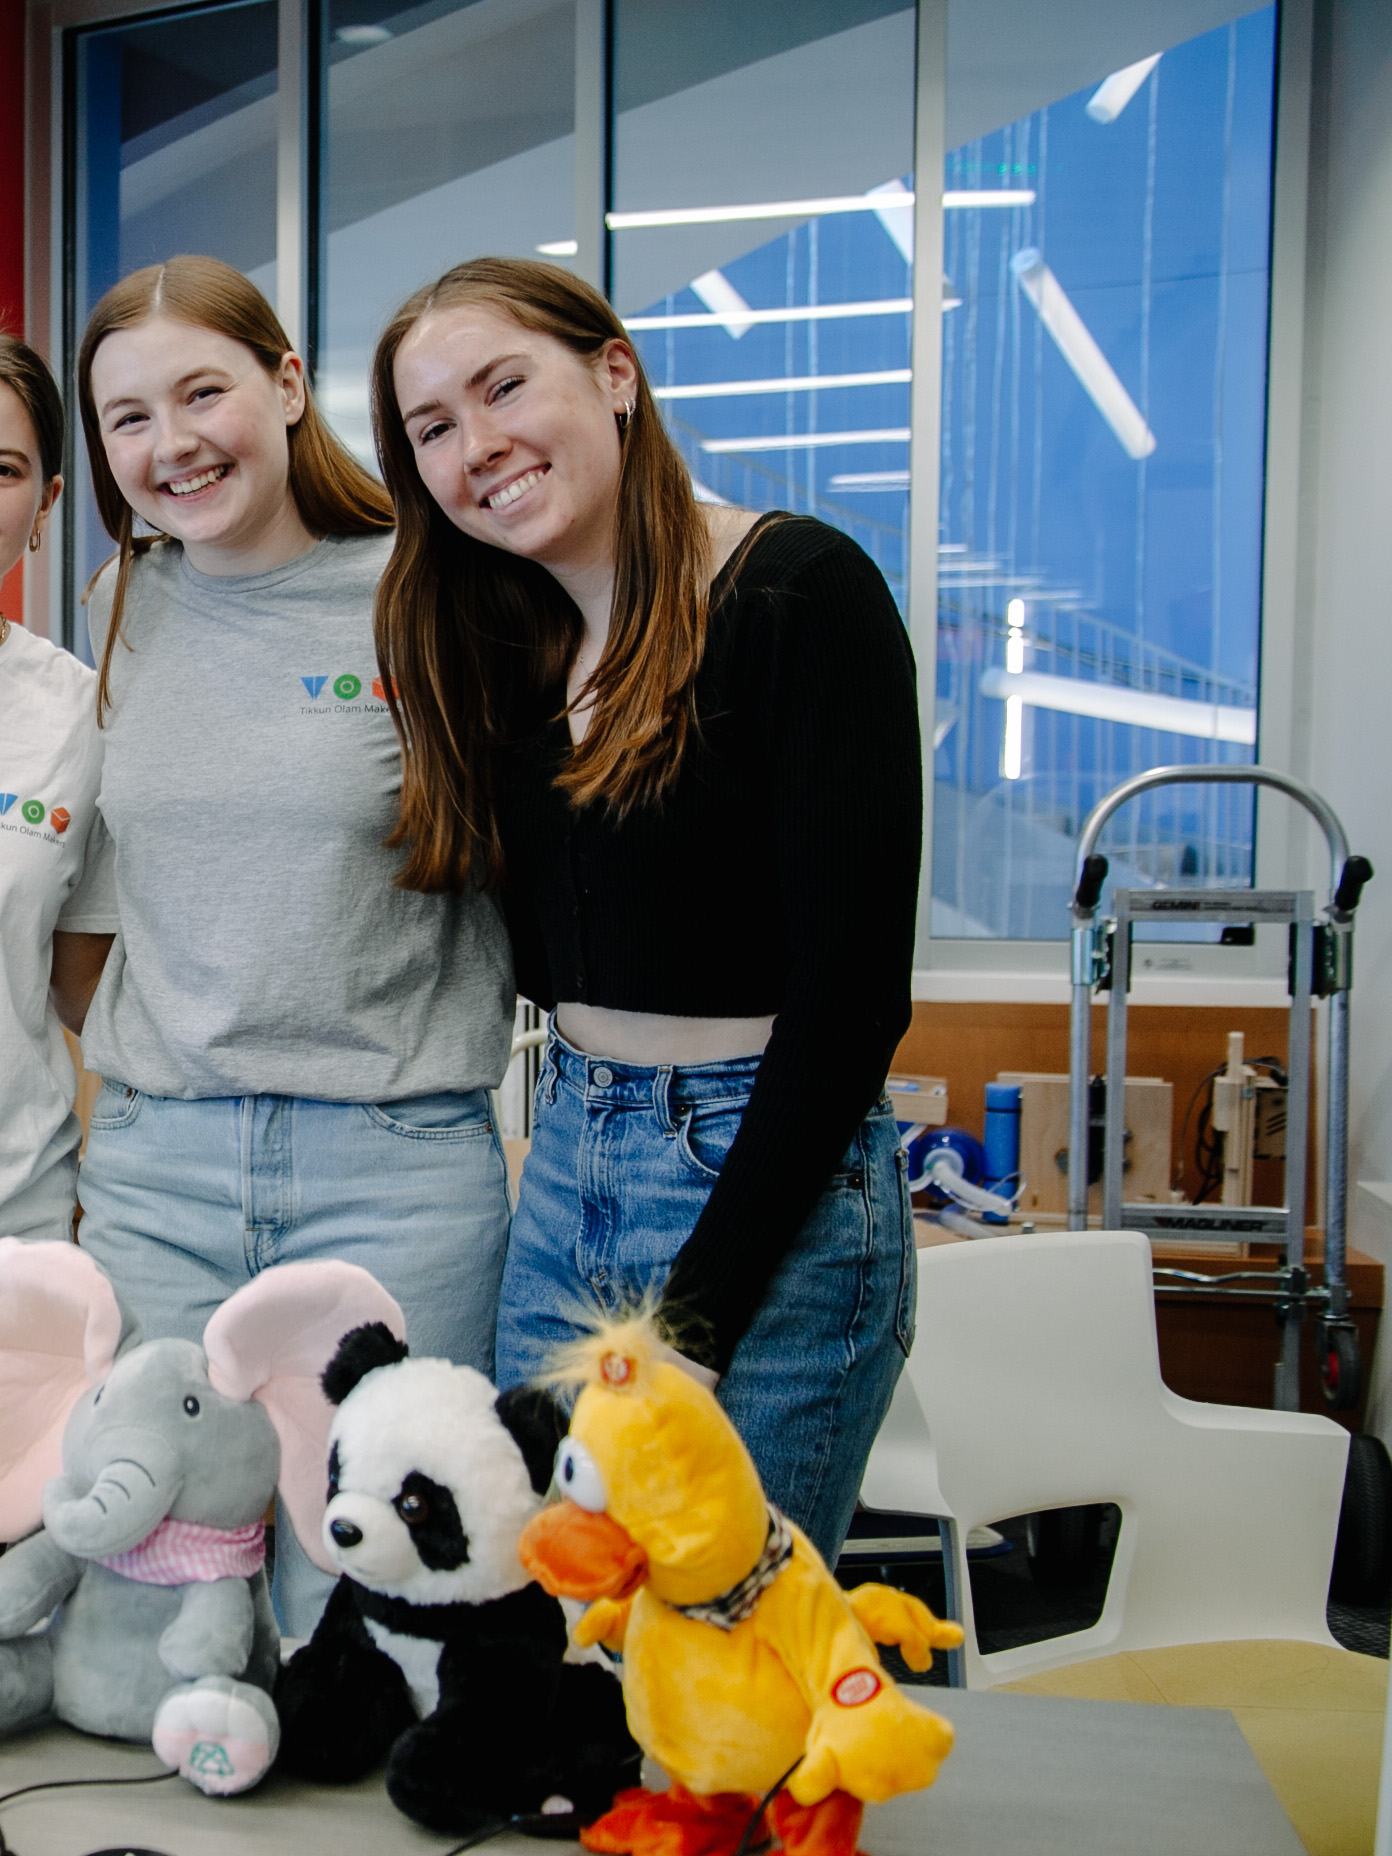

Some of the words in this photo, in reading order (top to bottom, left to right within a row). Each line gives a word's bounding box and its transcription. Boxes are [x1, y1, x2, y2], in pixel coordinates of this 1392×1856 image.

[299, 706, 332, 715] Tikkun
[334, 704, 361, 714] Olam
[19, 825, 42, 839] Olam
[43, 832, 66, 848] Makers
[1166, 1217, 1265, 1232] MAGLINER
